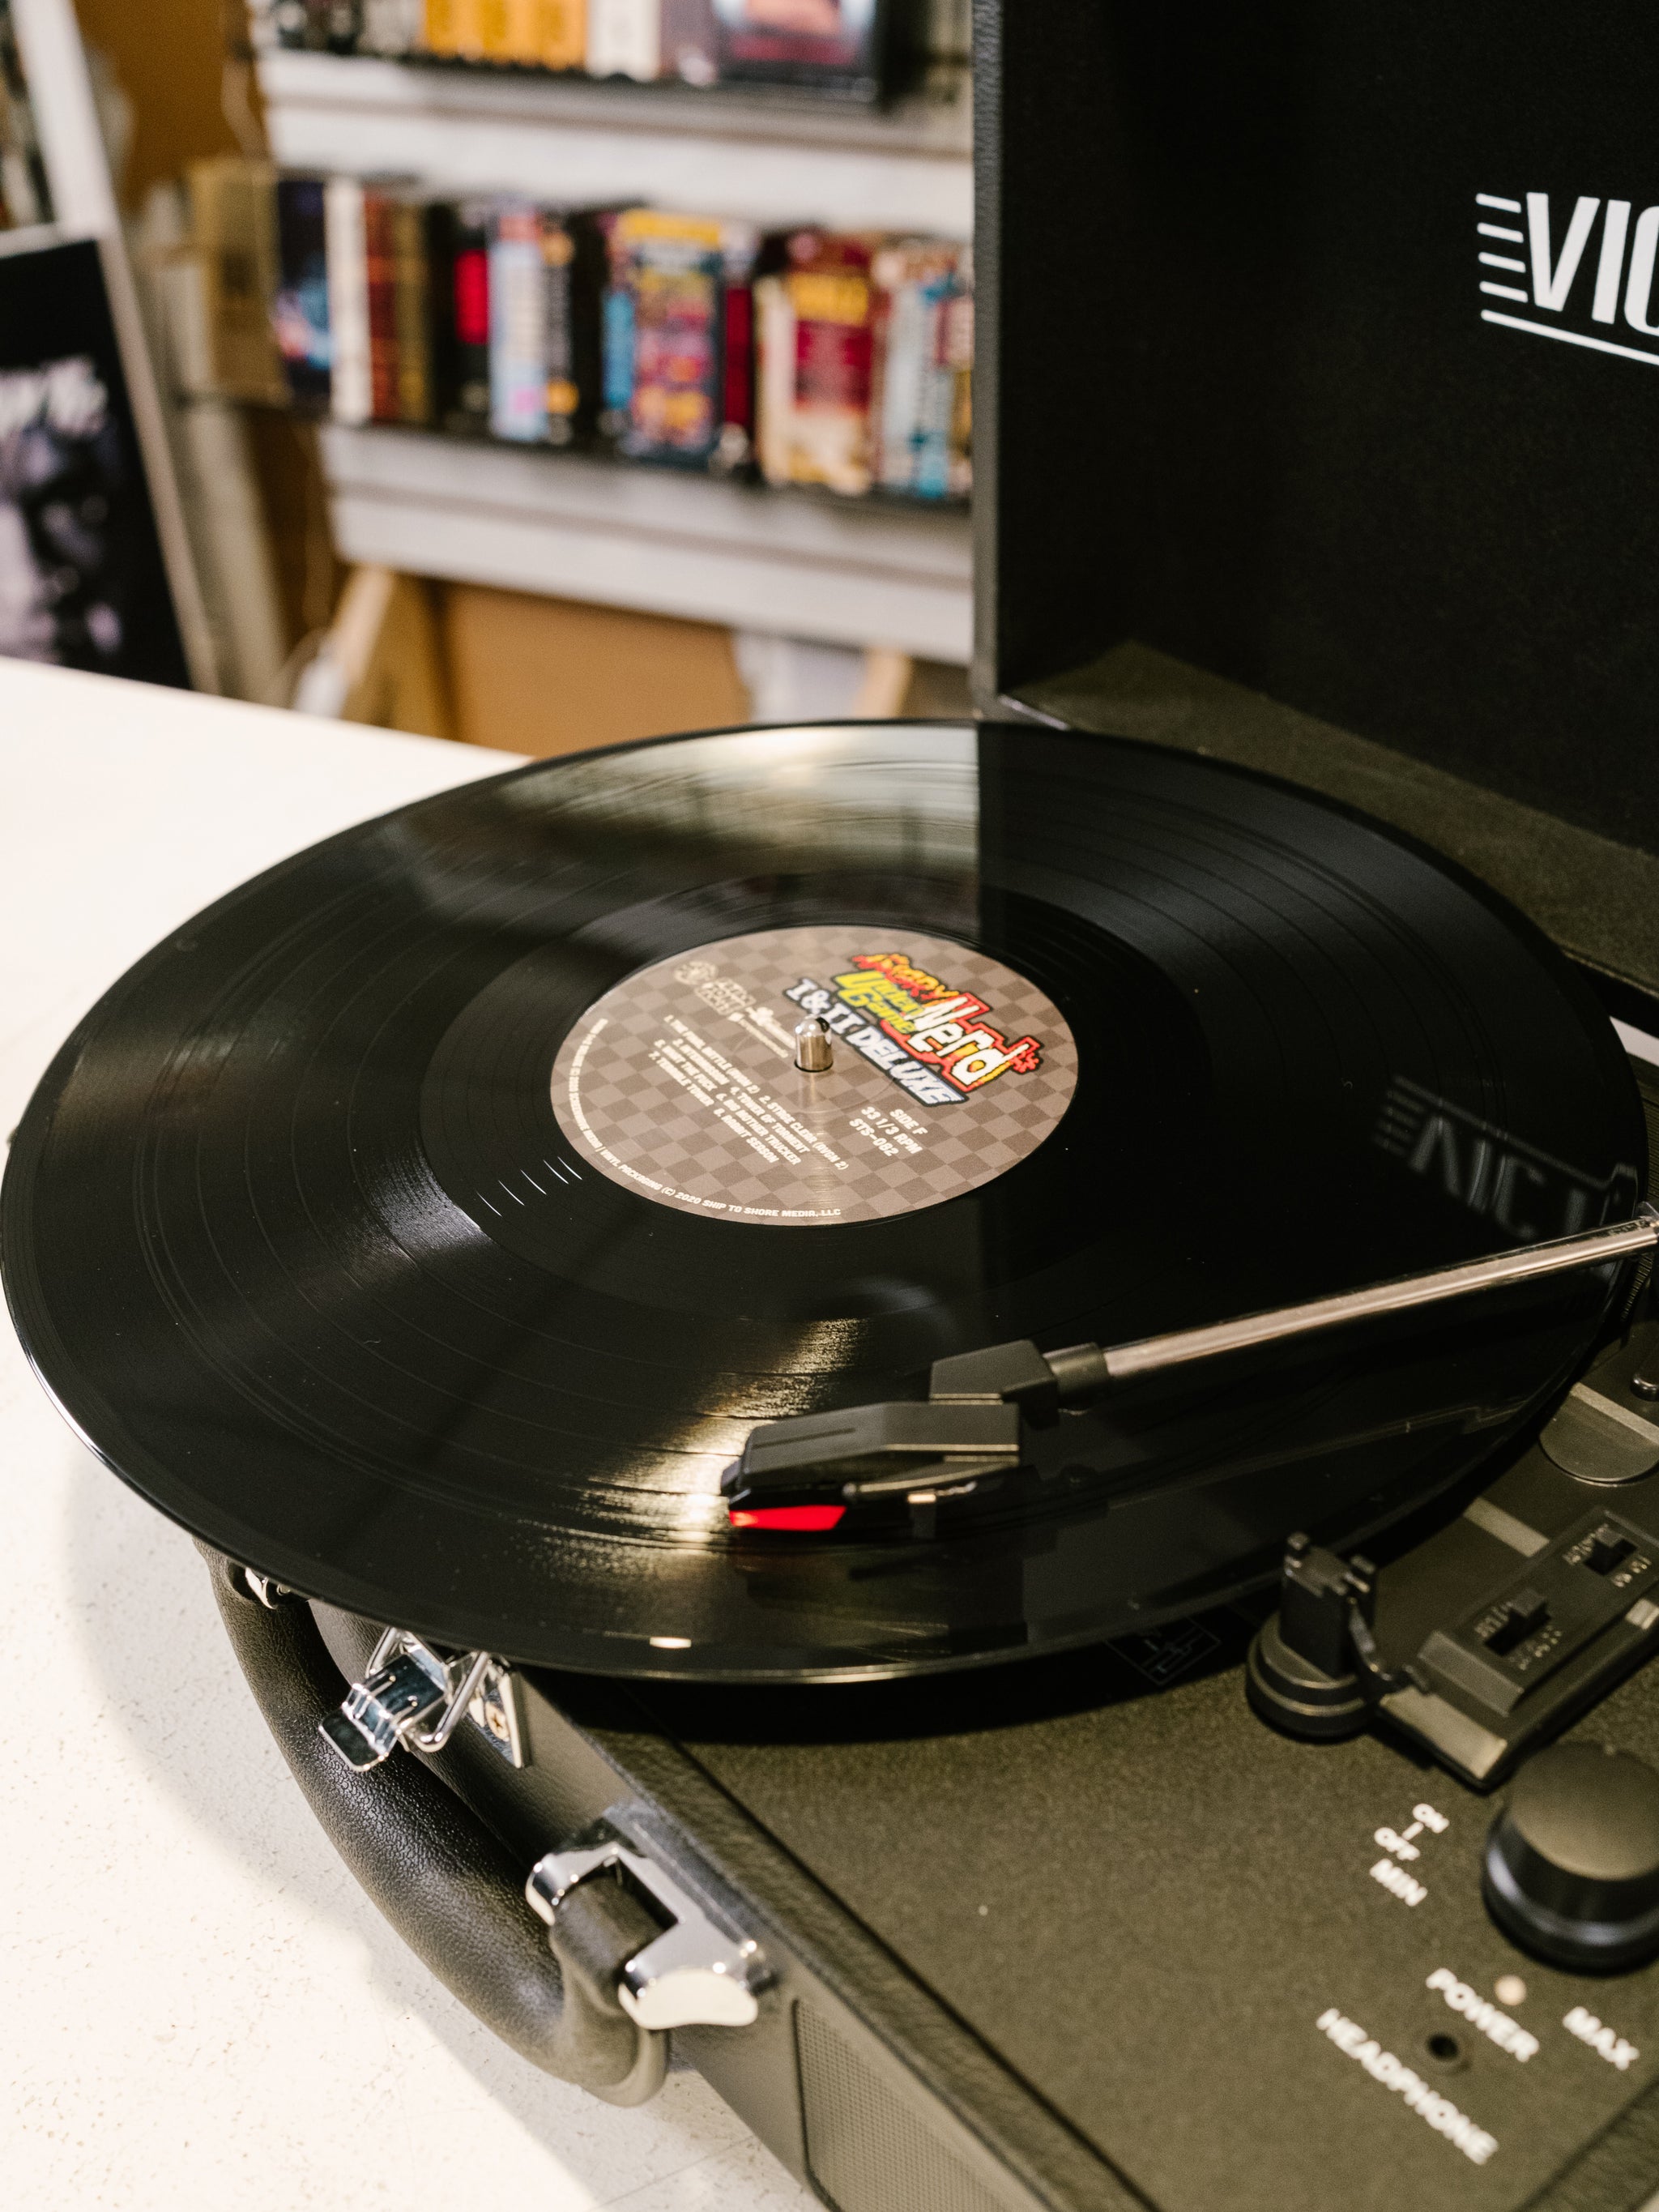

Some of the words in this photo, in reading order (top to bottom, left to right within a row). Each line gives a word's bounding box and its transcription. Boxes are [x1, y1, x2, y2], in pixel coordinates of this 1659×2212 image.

[694, 1074, 717, 1091] FUCK
[847, 1026, 965, 1105] DELUXE
[687, 1083, 714, 1106] TOWER
[730, 1087, 740, 1095] 4.
[737, 1092, 765, 1116] TOWER
[761, 1114, 776, 1123] OF
[772, 1123, 810, 1152] TORMENT
[890, 1109, 919, 1129] SIDE
[716, 1093, 727, 1101] 6.
[736, 1110, 769, 1136] MOTHER
[766, 1134, 801, 1164] TRUCKER
[721, 1115, 752, 1138] RABBIT
[747, 1137, 778, 1163] SEASON
[759, 1095, 770, 1104] 2.
[767, 1102, 795, 1124] STAGE
[790, 1122, 817, 1143] CLEAR
[812, 1142, 840, 1162] (AVGN
[834, 1161, 849, 1170] 2)
[850, 1119, 898, 1156] STS-082
[861, 1107, 881, 1120] 33
[876, 1118, 899, 1134] 1/3
[893, 1134, 923, 1154] RPM
[618, 1164, 663, 1190] PACKAGING
[661, 1187, 676, 1196] (C)
[675, 1192, 702, 1204] 2020
[702, 1200, 727, 1209] SHIP
[728, 1205, 742, 1213] TO
[744, 1207, 779, 1216] SHORE
[820, 1207, 841, 1216] LLC
[1412, 1803, 1450, 1834] ON
[1370, 1859, 1427, 1907] MIN
[1426, 1967, 1539, 2062] POWER
[1563, 2006, 1640, 2070] MAX
[1316, 2008, 1499, 2165] HEADPHONE
